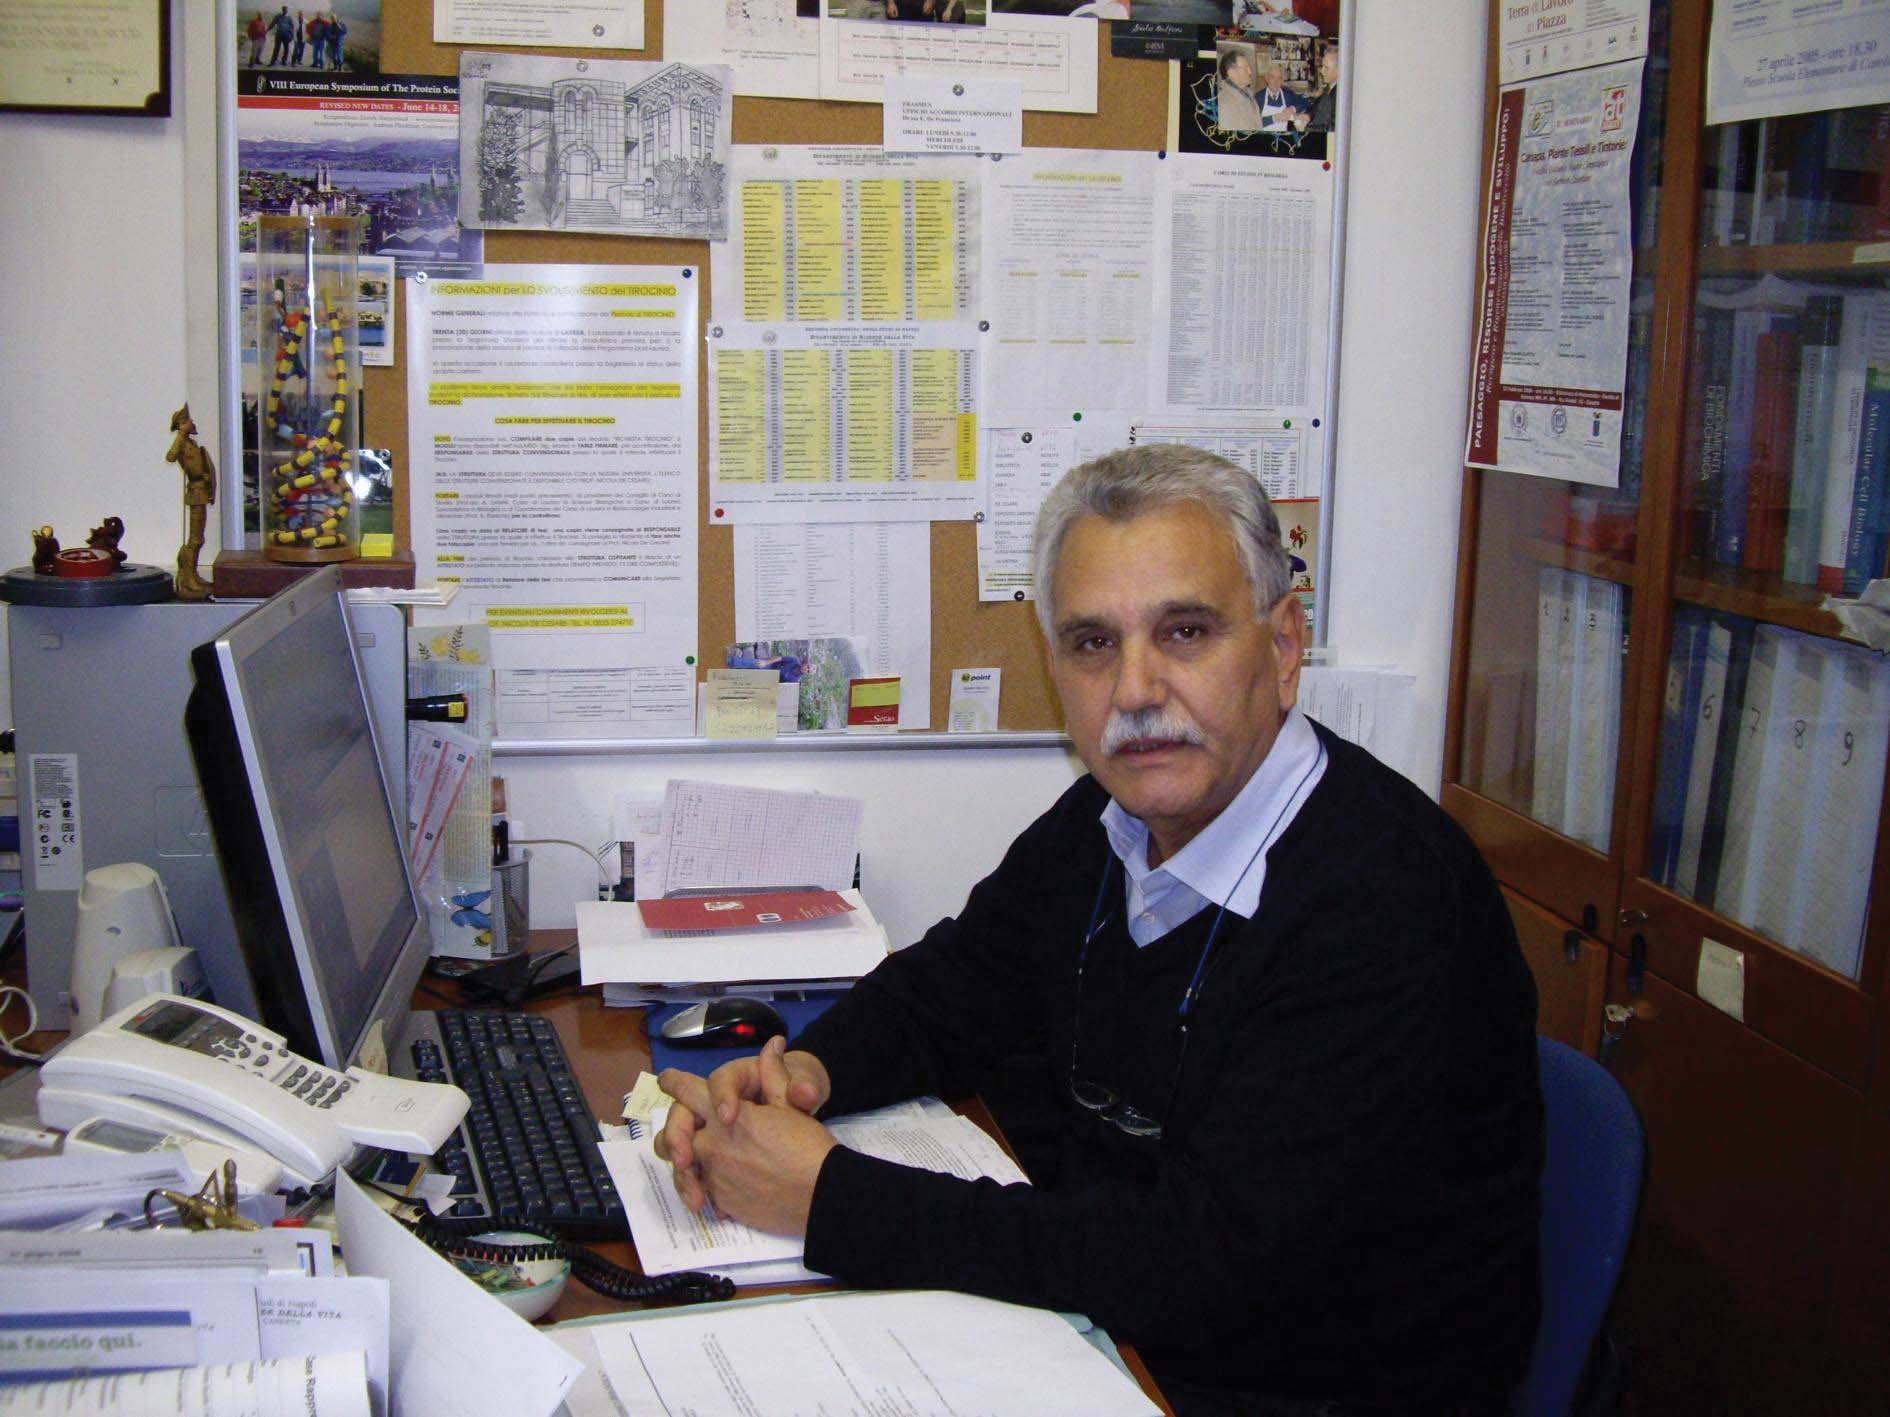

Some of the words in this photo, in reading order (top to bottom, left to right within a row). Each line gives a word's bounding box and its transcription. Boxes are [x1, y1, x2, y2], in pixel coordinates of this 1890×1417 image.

[1507, 6, 1529, 21] Terra
[1541, 0, 1576, 12] Lavoro
[1536, 13, 1567, 31] Piazza
[1769, 54, 1795, 72] aprile
[1828, 48, 1845, 59] ore
[270, 80, 287, 90] VIII
[289, 81, 329, 92] European
[331, 82, 379, 94] Symposium
[381, 83, 391, 92] of
[392, 83, 408, 93] The
[410, 84, 441, 94] Protein
[319, 102, 351, 110] REVISED
[371, 103, 394, 111] DATES
[402, 104, 422, 112] June
[1493, 191, 1502, 200] E
[1488, 205, 1501, 285] ENDOGENE
[431, 285, 501, 295] INFORMAZIONI
[504, 286, 520, 297] per
[522, 285, 536, 295] LO
[537, 285, 608, 296] SVOLGIMENTO
[610, 286, 626, 296] del
[628, 286, 677, 297] TIROCINIO
[1482, 289, 1495, 354] RISORSE
[1474, 359, 1488, 449] PAESAGGIO,
[1701, 402, 1716, 482] BIOCHIMICA
[1711, 384, 1728, 474] FONDAMENTI
[1861, 403, 1880, 473] Molecular
[1858, 476, 1874, 504] Cell
[1850, 507, 1868, 557] Biology
[970, 674, 992, 682] point
[1702, 693, 1716, 720] 6
[1749, 706, 1762, 738] 7
[1793, 719, 1807, 750] 8
[1842, 731, 1854, 766] 9
[277, 1309, 312, 1318] DELLA
[317, 1311, 342, 1319] VITA
[288, 1300, 318, 1309] Napoli
[23, 1335, 94, 1351] faccio
[97, 1333, 142, 1354] qui.
